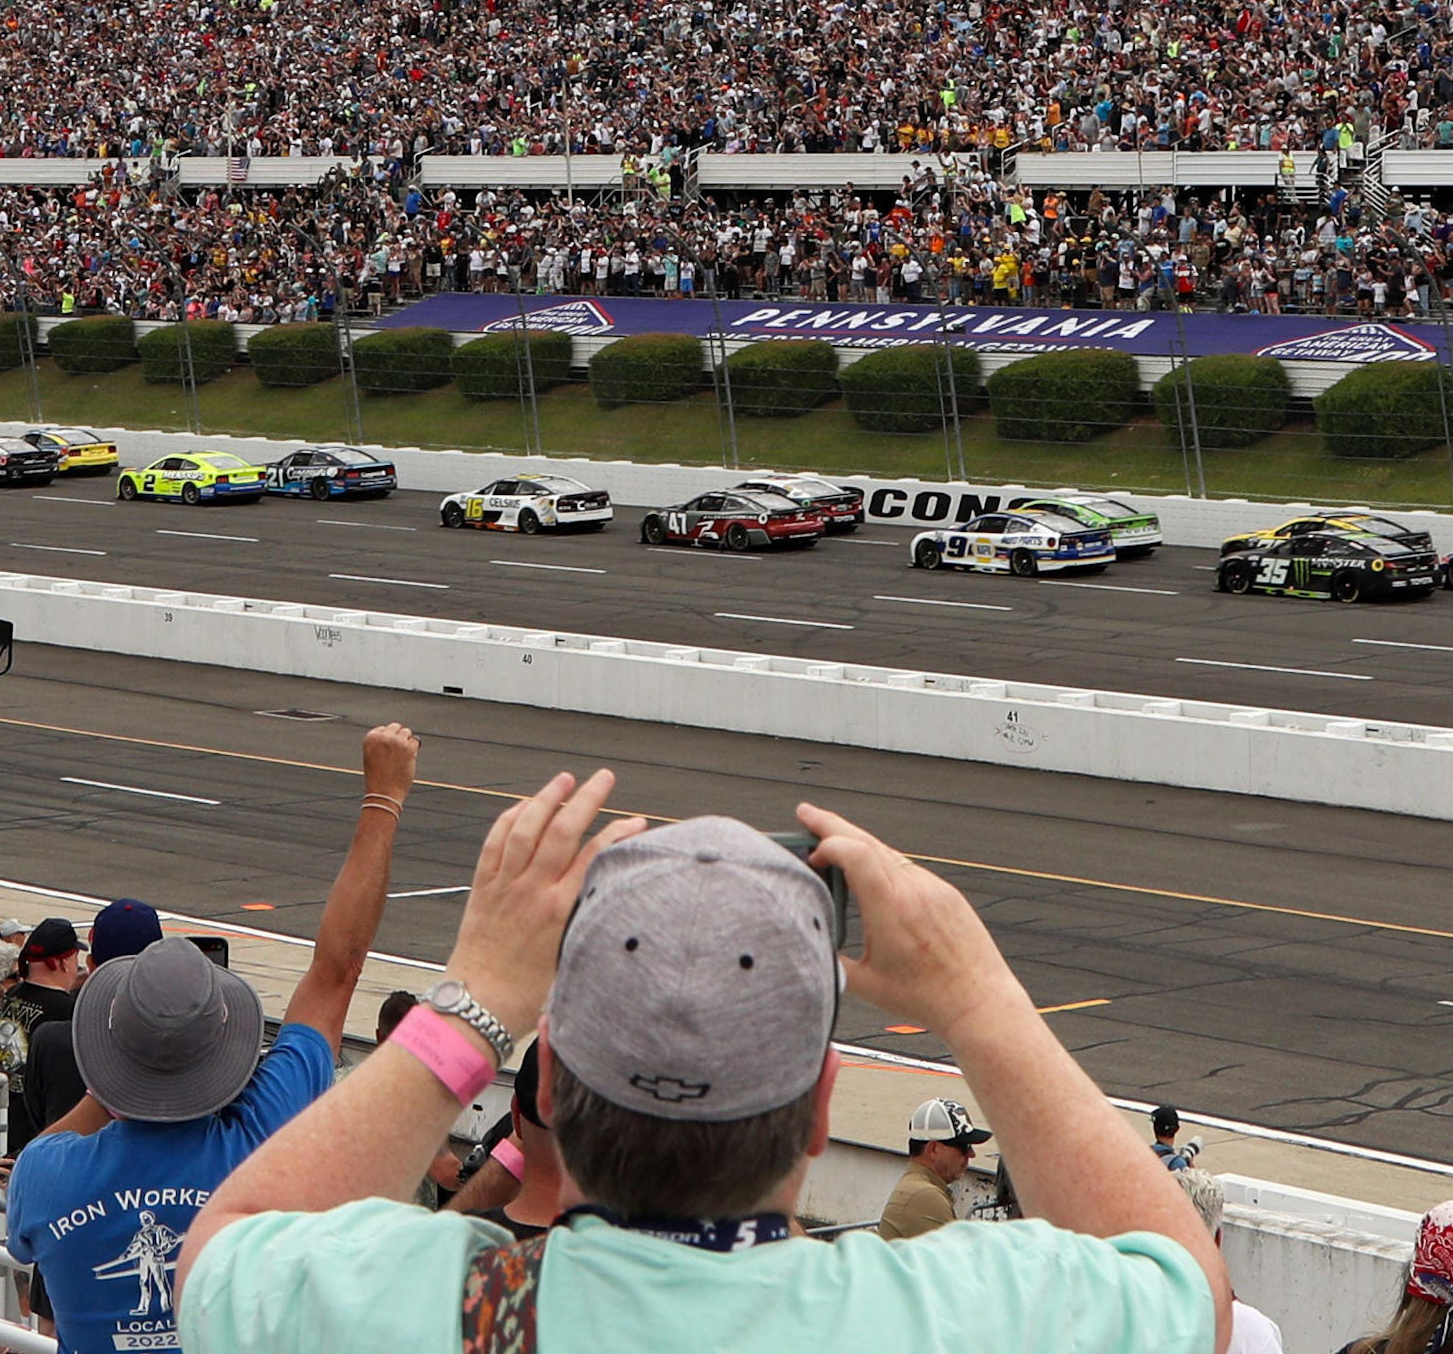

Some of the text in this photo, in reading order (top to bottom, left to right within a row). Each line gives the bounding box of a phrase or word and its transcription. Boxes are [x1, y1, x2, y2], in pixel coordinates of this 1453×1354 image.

[731, 308, 1156, 339] PENNSYLVANIA
[1269, 347, 1355, 357] GETAWAY
[1300, 341, 1396, 350] AMERICAN
[161, 468, 205, 481] MENARDS
[268, 467, 284, 488] 21
[143, 475, 156, 492] 2
[466, 498, 483, 519] 16
[488, 497, 521, 509] CELSIUS
[668, 512, 688, 535] 47
[948, 536, 968, 558] 9
[1255, 557, 1291, 585] 35
[522, 653, 533, 665] 40
[1006, 711, 1018, 723] 41
[49, 1188, 210, 1241] IRON WORKE
[731, 1220, 758, 1253] 5
[116, 1319, 177, 1333] LOCAL
[126, 1333, 179, 1348] 2022
